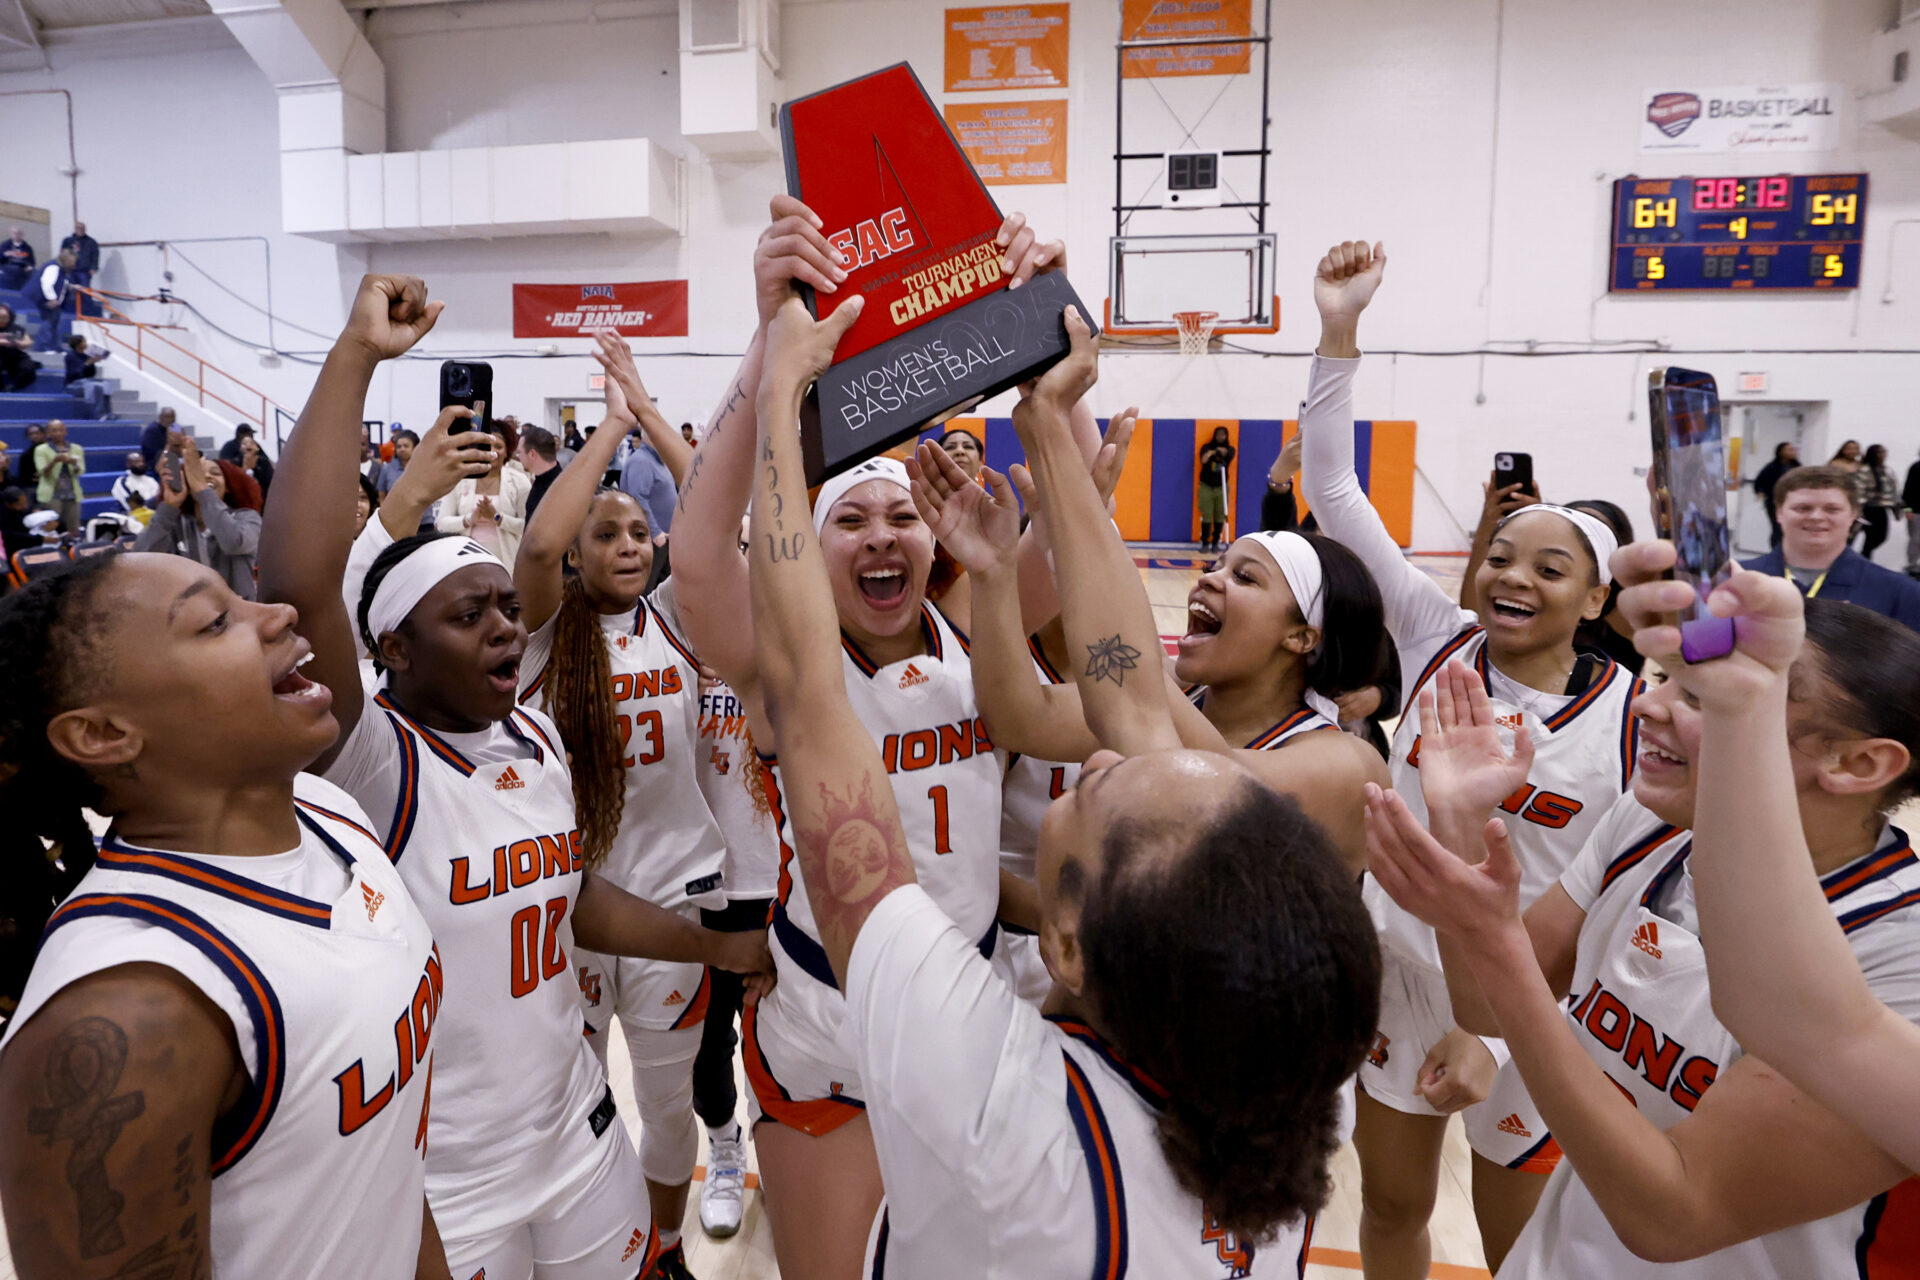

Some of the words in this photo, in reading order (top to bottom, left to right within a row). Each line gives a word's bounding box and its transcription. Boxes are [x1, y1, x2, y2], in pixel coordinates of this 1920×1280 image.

[1709, 97, 1833, 118] BASKETBALL
[1694, 177, 1788, 209] 20:12
[1811, 193, 1858, 225] 54
[1633, 198, 1677, 229] 64
[1729, 216, 1748, 239] 4
[828, 206, 914, 274] SAC
[1647, 257, 1665, 279] 5
[1824, 254, 1844, 277] 5
[582, 285, 615, 300] NAIA
[551, 312, 582, 326] RED
[582, 311, 645, 326] BANNER
[840, 336, 1016, 431] BASKETBALL
[842, 340, 949, 400] WOMEN'S
[611, 665, 683, 702] ONS
[898, 674, 930, 690] adidas
[495, 780, 525, 791] adidas
[928, 784, 954, 855] 1
[449, 828, 583, 906] LIONS
[332, 939, 444, 1137] LION
[1568, 978, 1719, 1113] IONS
